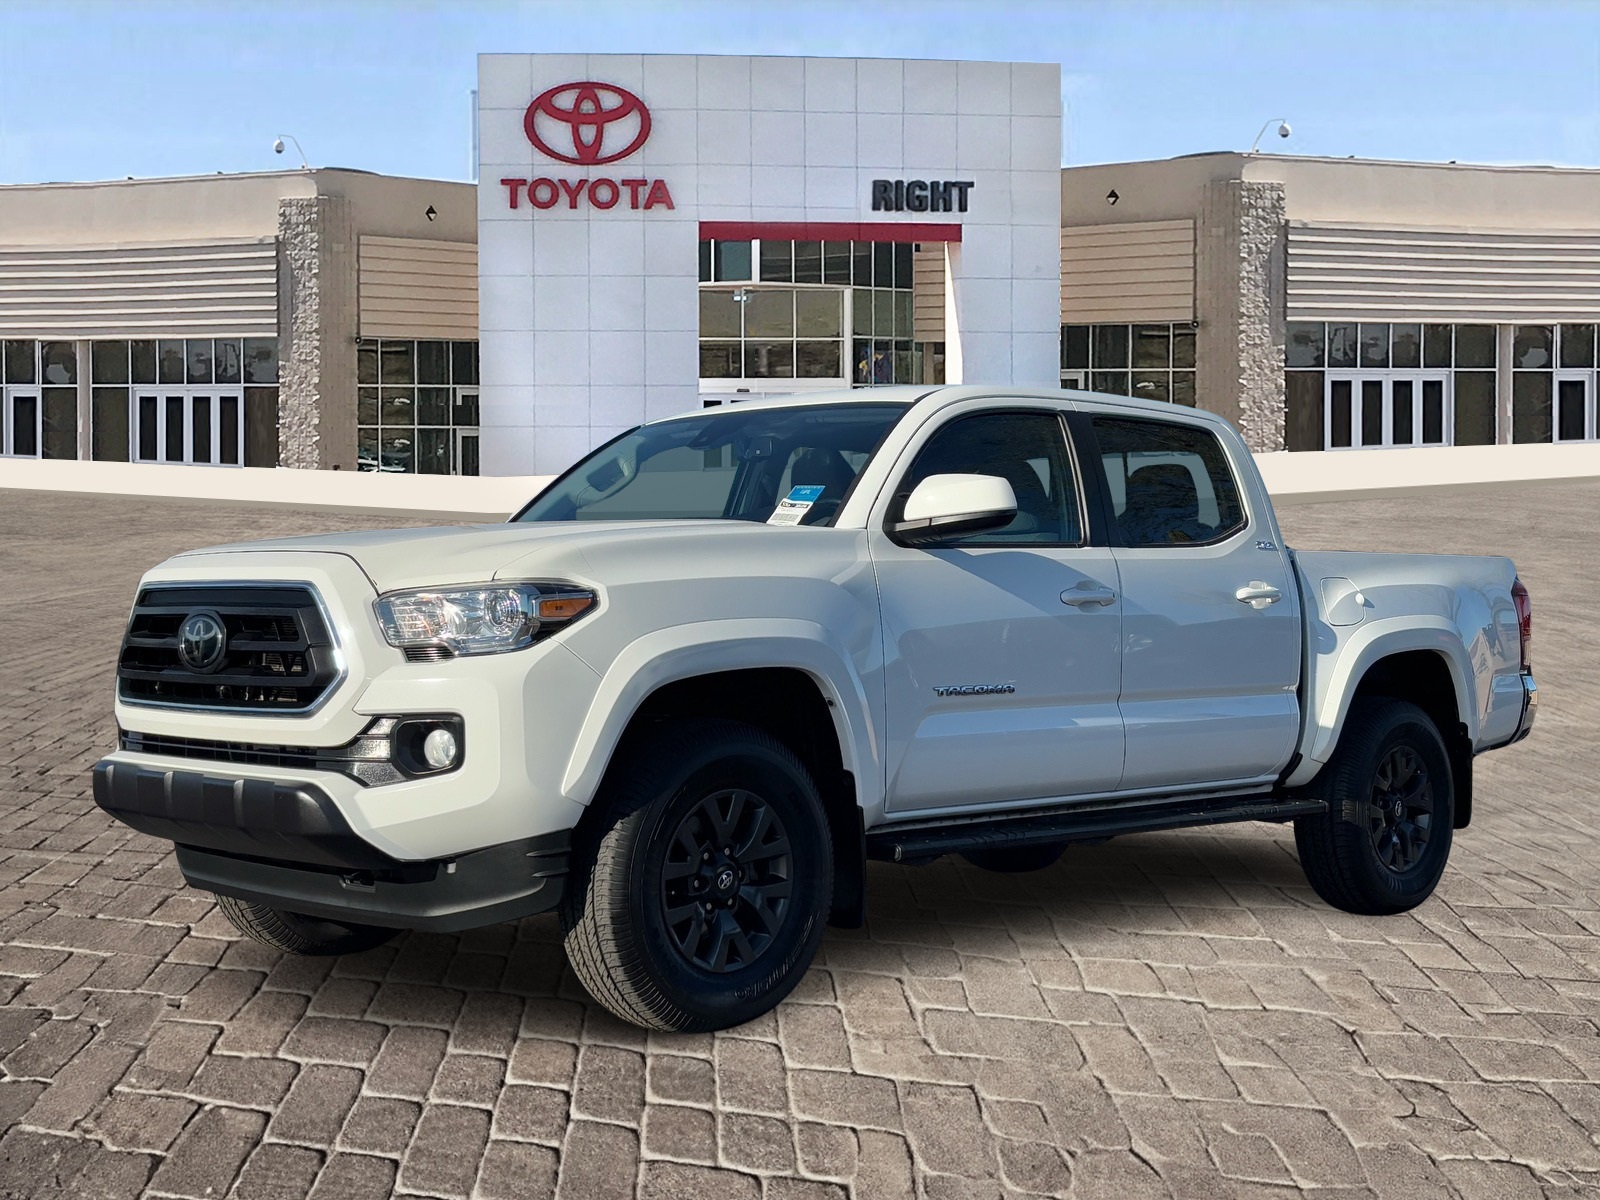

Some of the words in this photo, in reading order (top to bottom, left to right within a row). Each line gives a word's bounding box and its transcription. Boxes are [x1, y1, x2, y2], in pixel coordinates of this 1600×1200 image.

[500, 178, 676, 210] TOYOTA
[871, 179, 975, 212] RIGHT
[933, 684, 1016, 697] TACOMA
